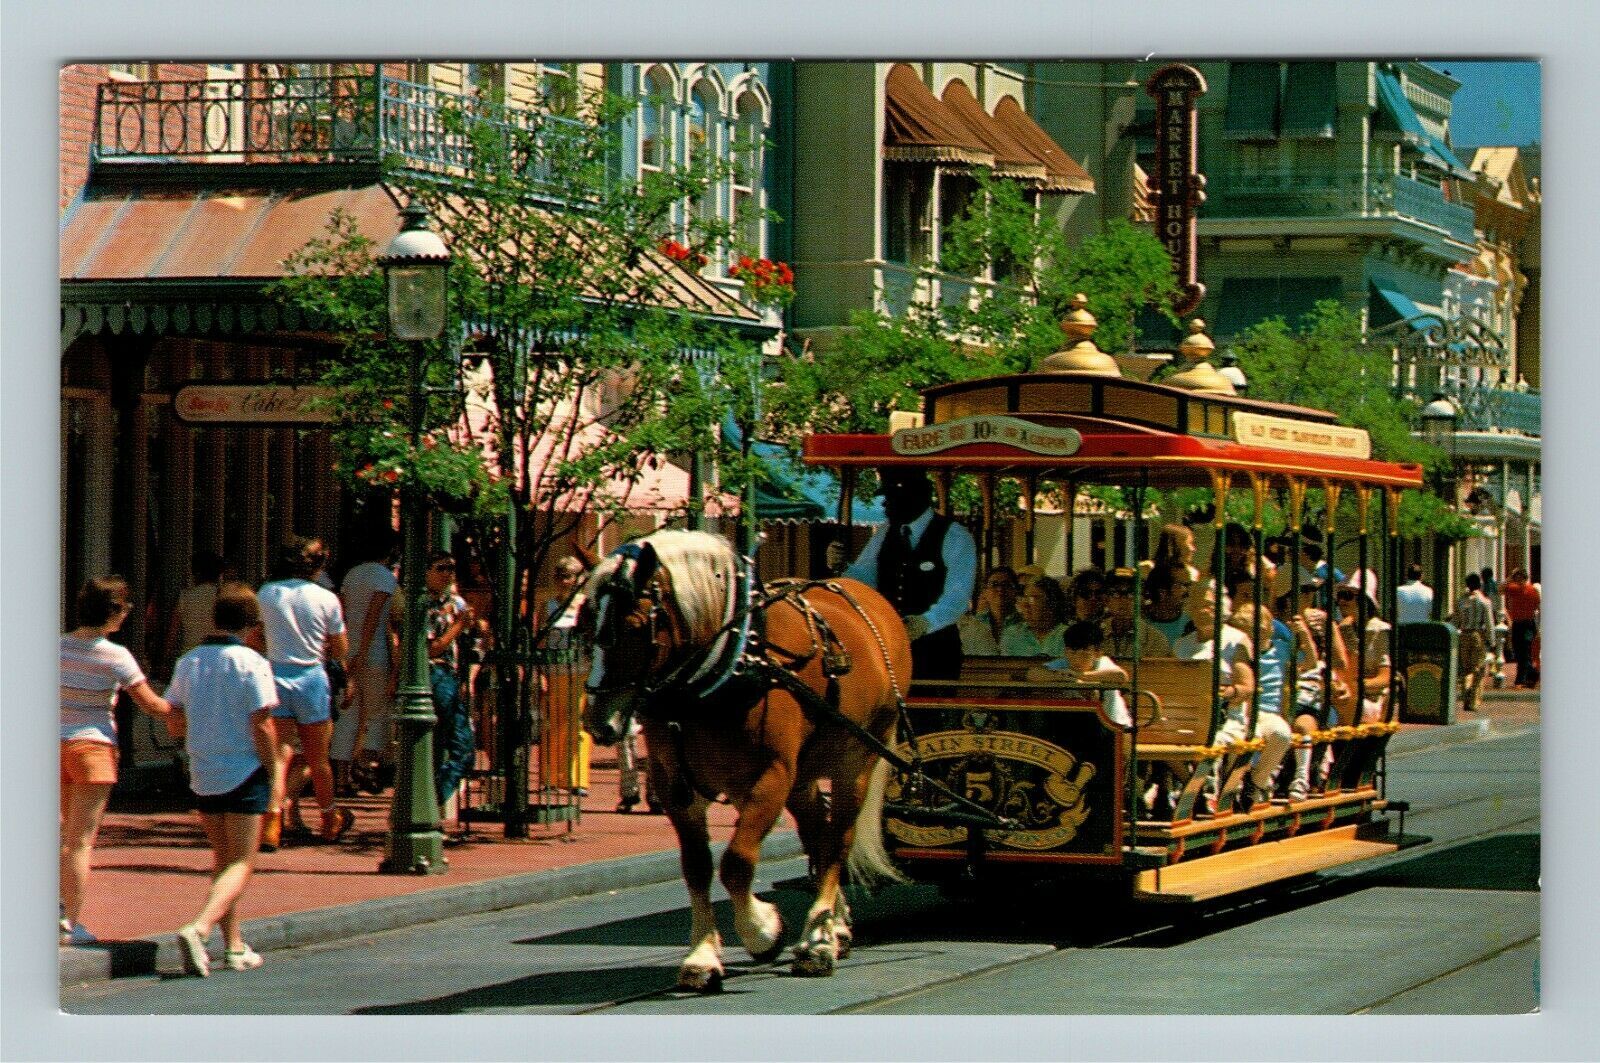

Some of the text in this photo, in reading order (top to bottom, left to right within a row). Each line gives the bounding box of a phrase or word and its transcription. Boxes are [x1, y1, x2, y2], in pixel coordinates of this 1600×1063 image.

[1167, 90, 1184, 195] MARKET
[1167, 205, 1183, 272] HOUS
[902, 430, 944, 450] FARE
[973, 737, 1055, 761] STREET
[966, 772, 993, 801] 5
